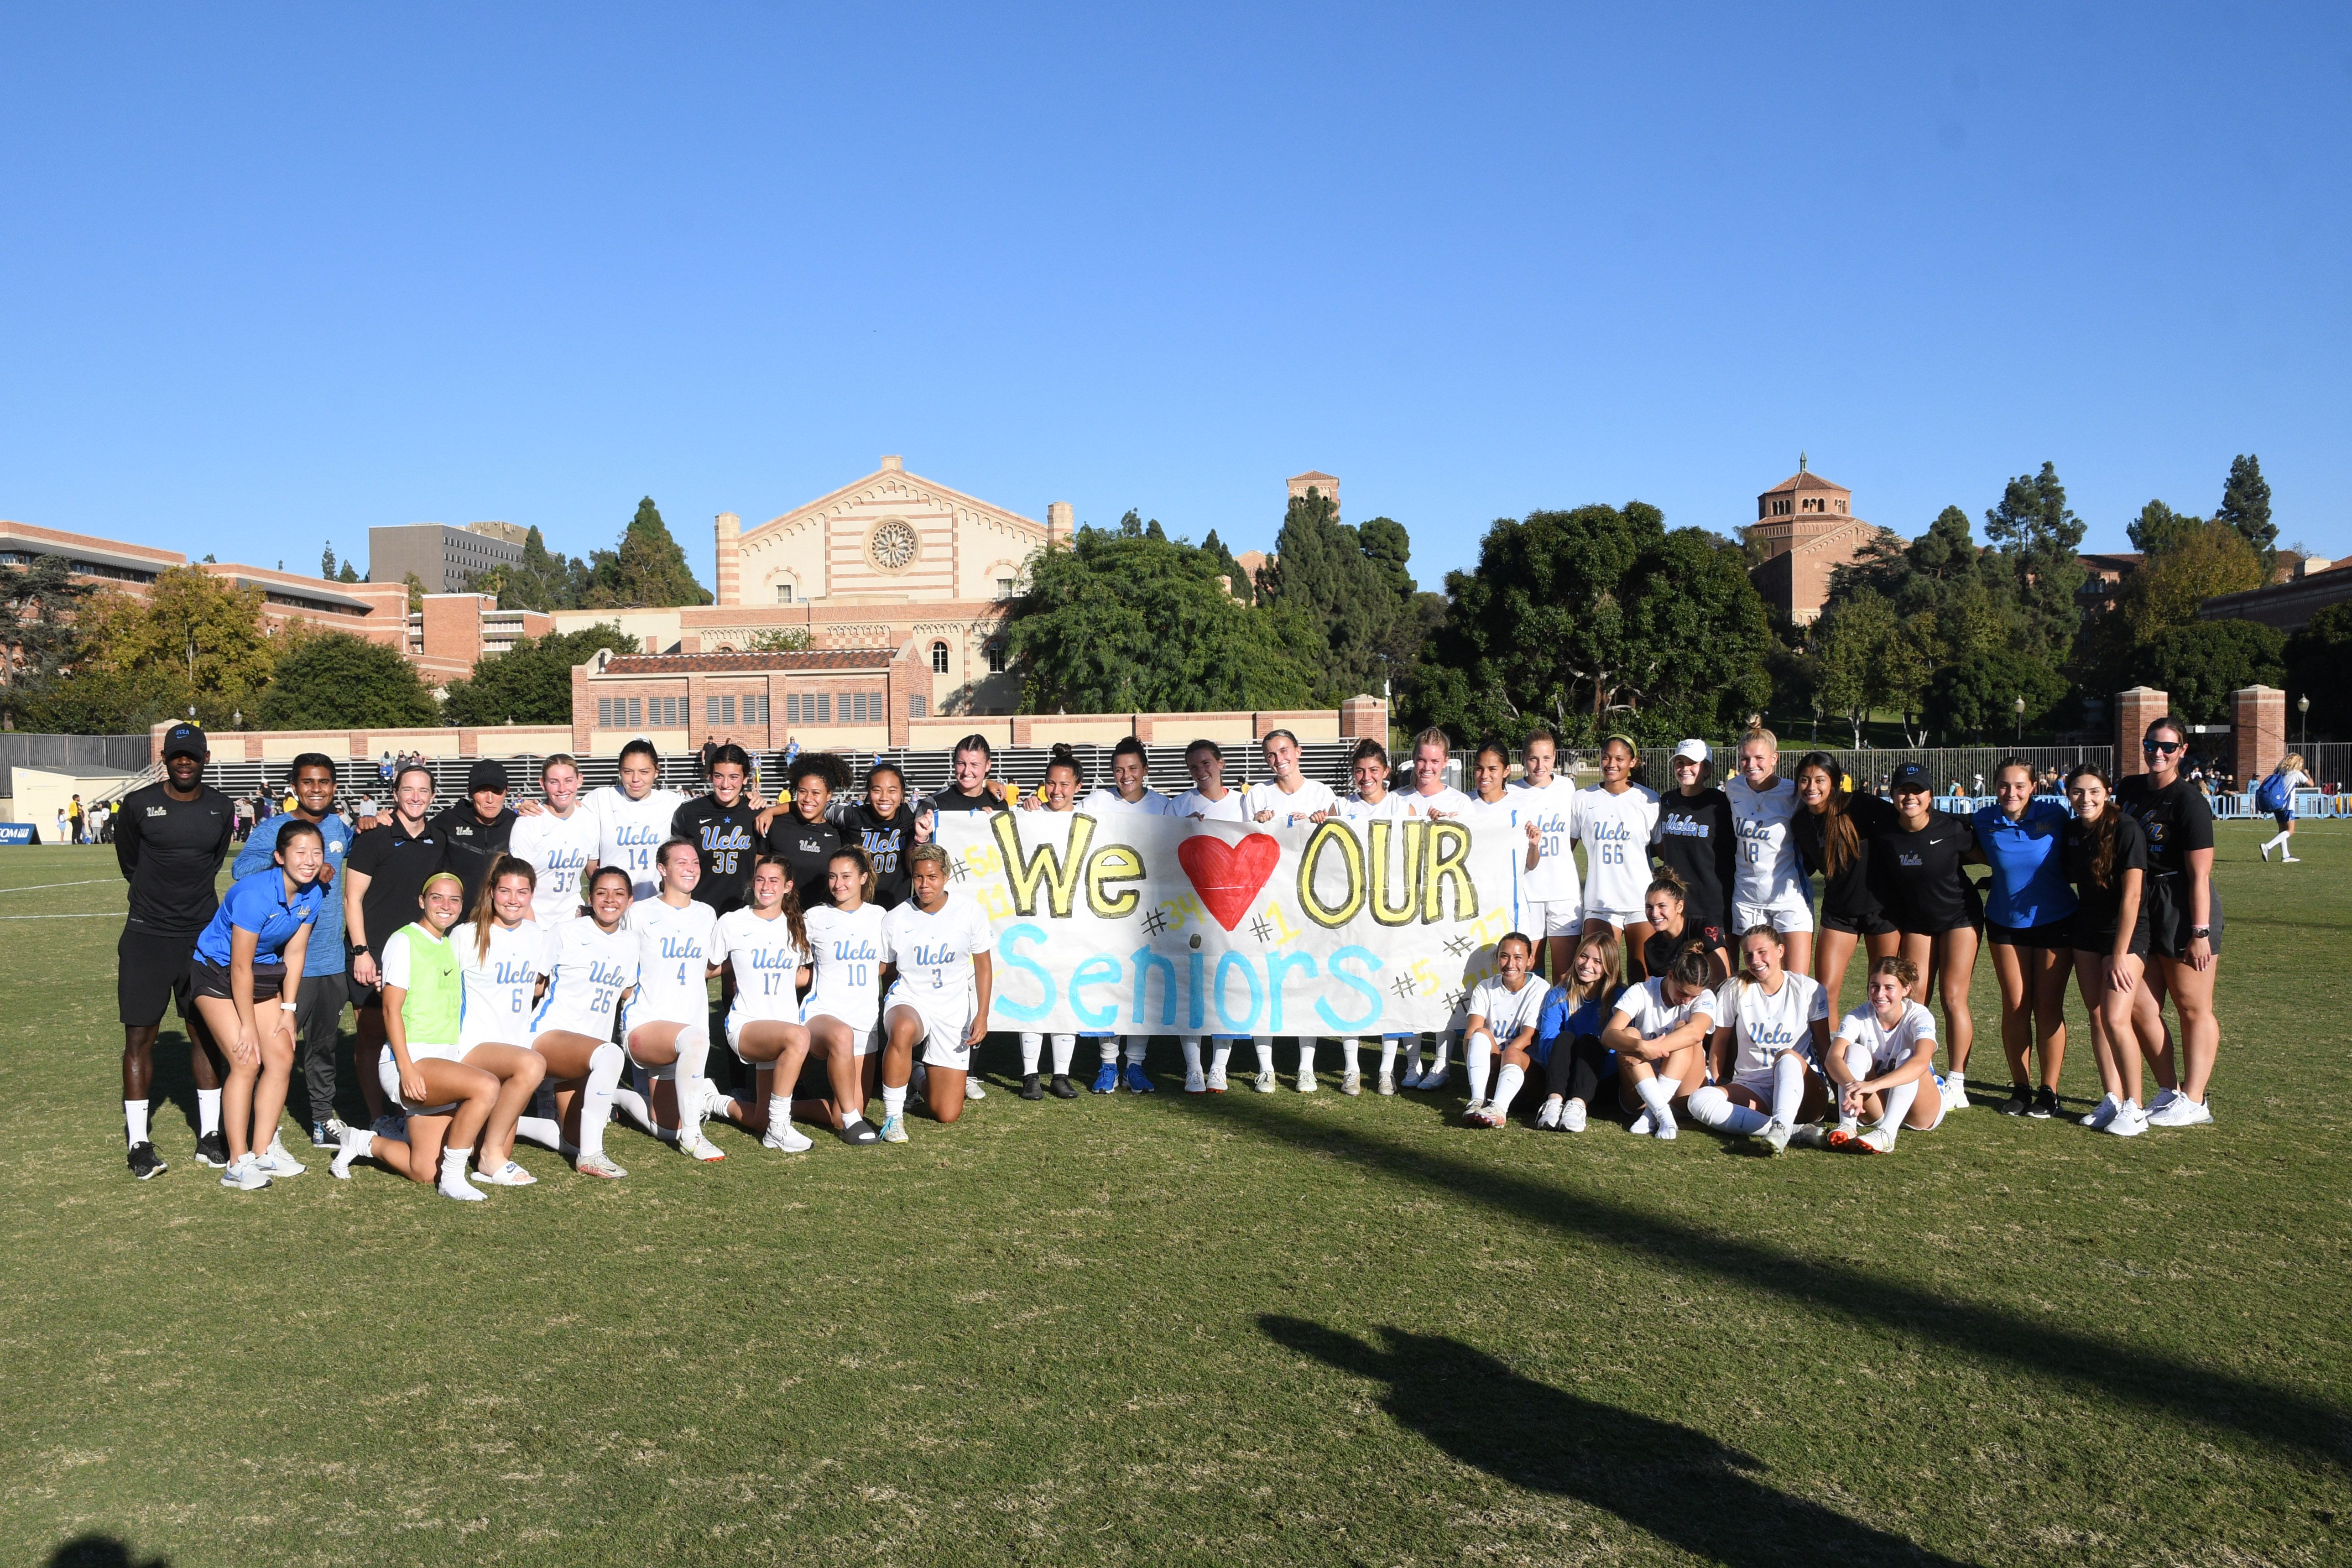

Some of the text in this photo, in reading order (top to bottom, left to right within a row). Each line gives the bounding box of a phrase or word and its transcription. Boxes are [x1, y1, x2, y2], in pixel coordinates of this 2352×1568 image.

[146, 806, 167, 817] Ucla
[1666, 813, 1697, 832] Ucla
[0, 828, 18, 838] OM
[456, 826, 474, 836] Ucla
[616, 825, 660, 846] Ucla
[700, 825, 751, 850] Ucla
[1593, 821, 1630, 841] Ucla
[1736, 817, 1771, 841] Ucla
[799, 839, 821, 853] Ucla
[861, 828, 905, 854] Ucla
[1539, 836, 1559, 857] 20
[1743, 840, 1759, 864] 18
[548, 848, 584, 869] Ucla
[628, 849, 648, 870] 14
[712, 851, 738, 874] 36
[874, 853, 897, 874] 00
[1602, 844, 1623, 865] 66
[1899, 854, 1923, 866] Ucla
[990, 810, 1478, 929] We OUR
[1141, 892, 1206, 936] #34
[1248, 900, 1301, 947] #1
[660, 936, 703, 959] Ucla
[751, 948, 793, 969] Ucla
[833, 939, 877, 961] Ucla
[913, 943, 956, 966] Ucla
[495, 960, 536, 985] Ucla
[589, 960, 625, 988] Ucla
[676, 962, 686, 986] 4
[848, 964, 866, 986] 10
[932, 968, 943, 989] 3
[995, 923, 1383, 1031] Seniors
[1390, 958, 1440, 999] #5
[764, 973, 782, 995] 17
[511, 988, 523, 1013] 6
[590, 988, 614, 1014] 26
[1493, 1020, 1520, 1040] Ucl
[1749, 1022, 1793, 1044] Ucla
